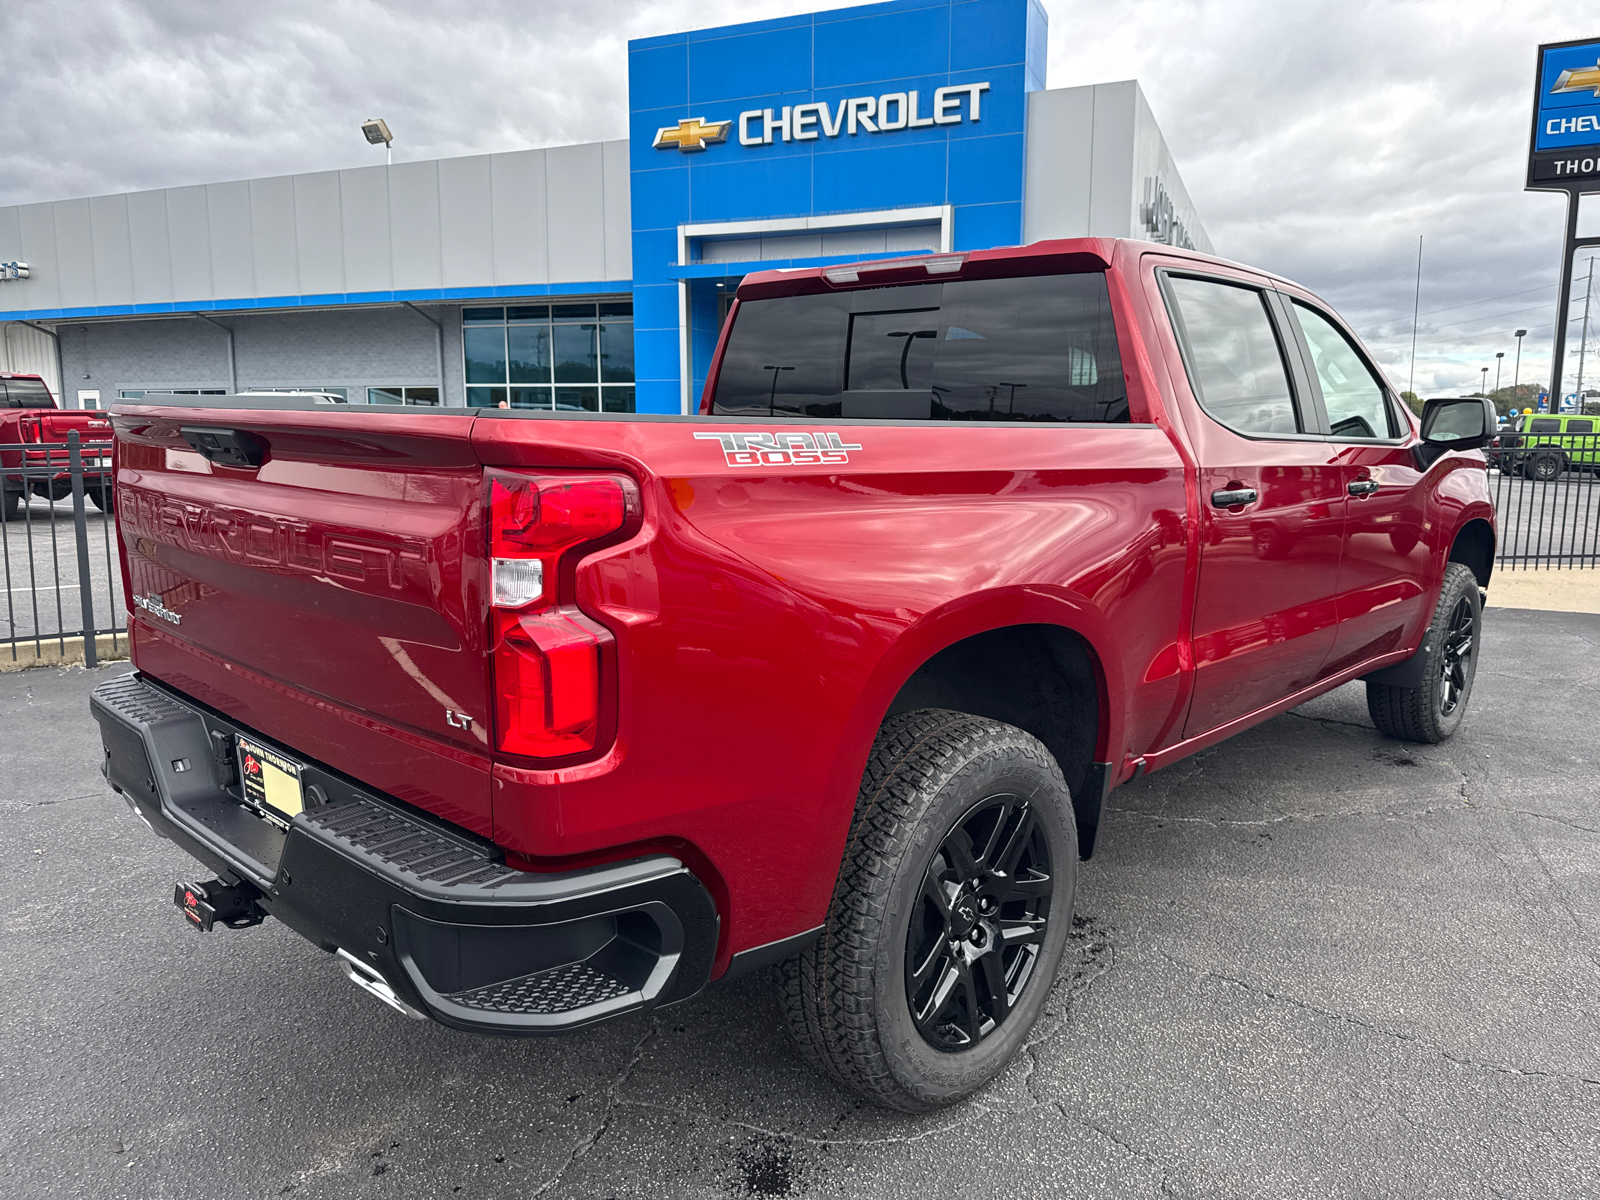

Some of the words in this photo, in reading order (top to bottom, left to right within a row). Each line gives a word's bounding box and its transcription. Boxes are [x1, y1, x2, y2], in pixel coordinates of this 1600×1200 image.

[738, 82, 990, 146] CHEVROLET
[693, 432, 863, 451] TRAIL
[724, 450, 849, 467] BOSS
[118, 485, 423, 590] CHEVROLET
[446, 710, 474, 730] LT
